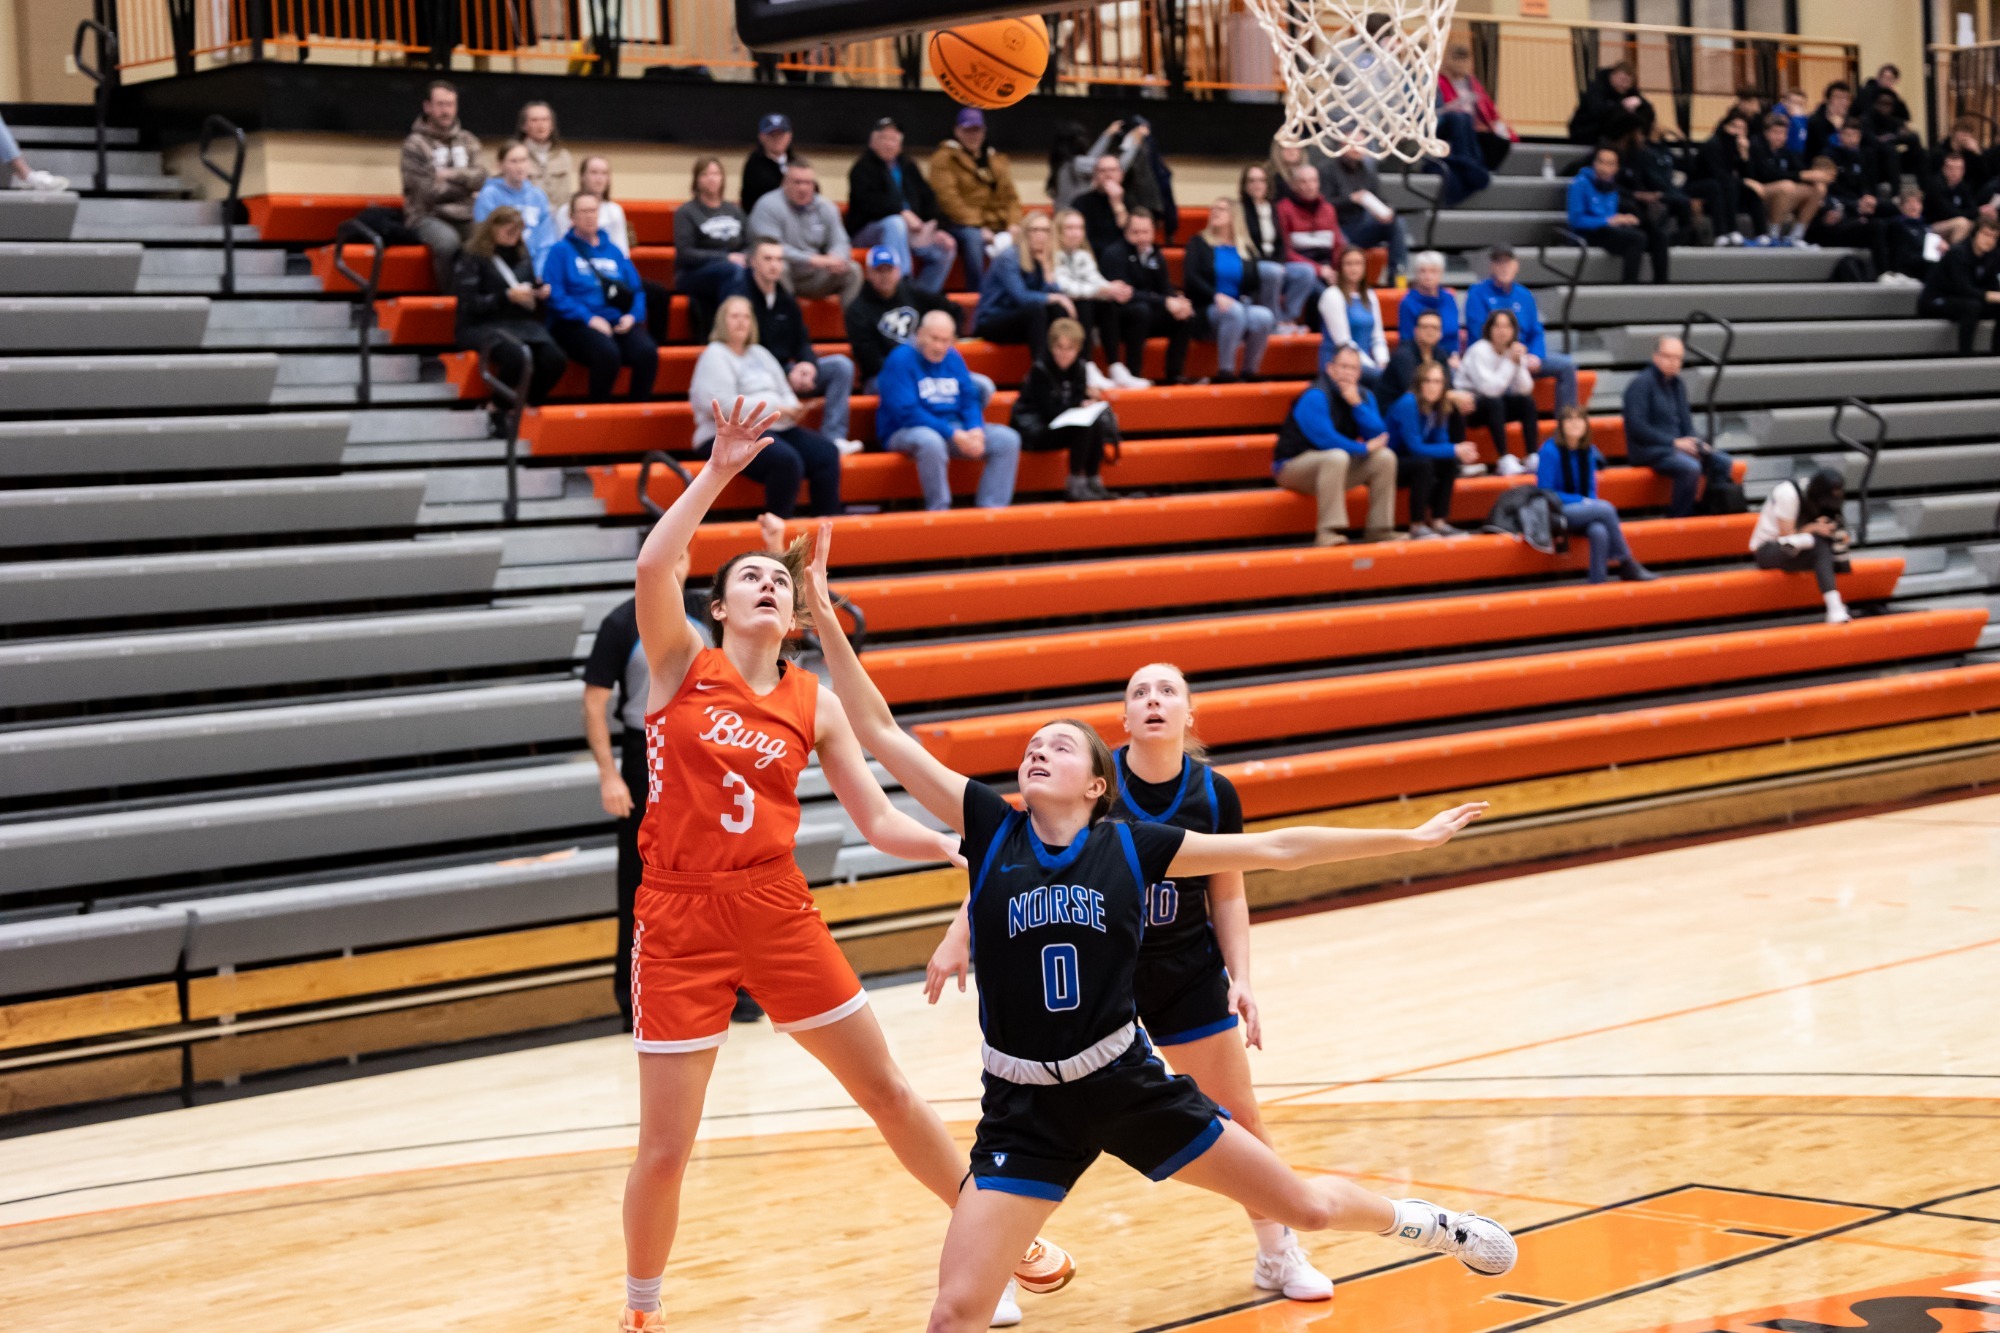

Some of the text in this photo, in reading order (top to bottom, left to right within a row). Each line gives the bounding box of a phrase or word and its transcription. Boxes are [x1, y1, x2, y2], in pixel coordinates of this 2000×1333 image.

[699, 705, 788, 770] 'Burg
[720, 770, 755, 834] 3
[1008, 884, 1107, 939] NORSE
[1144, 880, 1179, 927] 0
[1041, 943, 1081, 1012] 0
